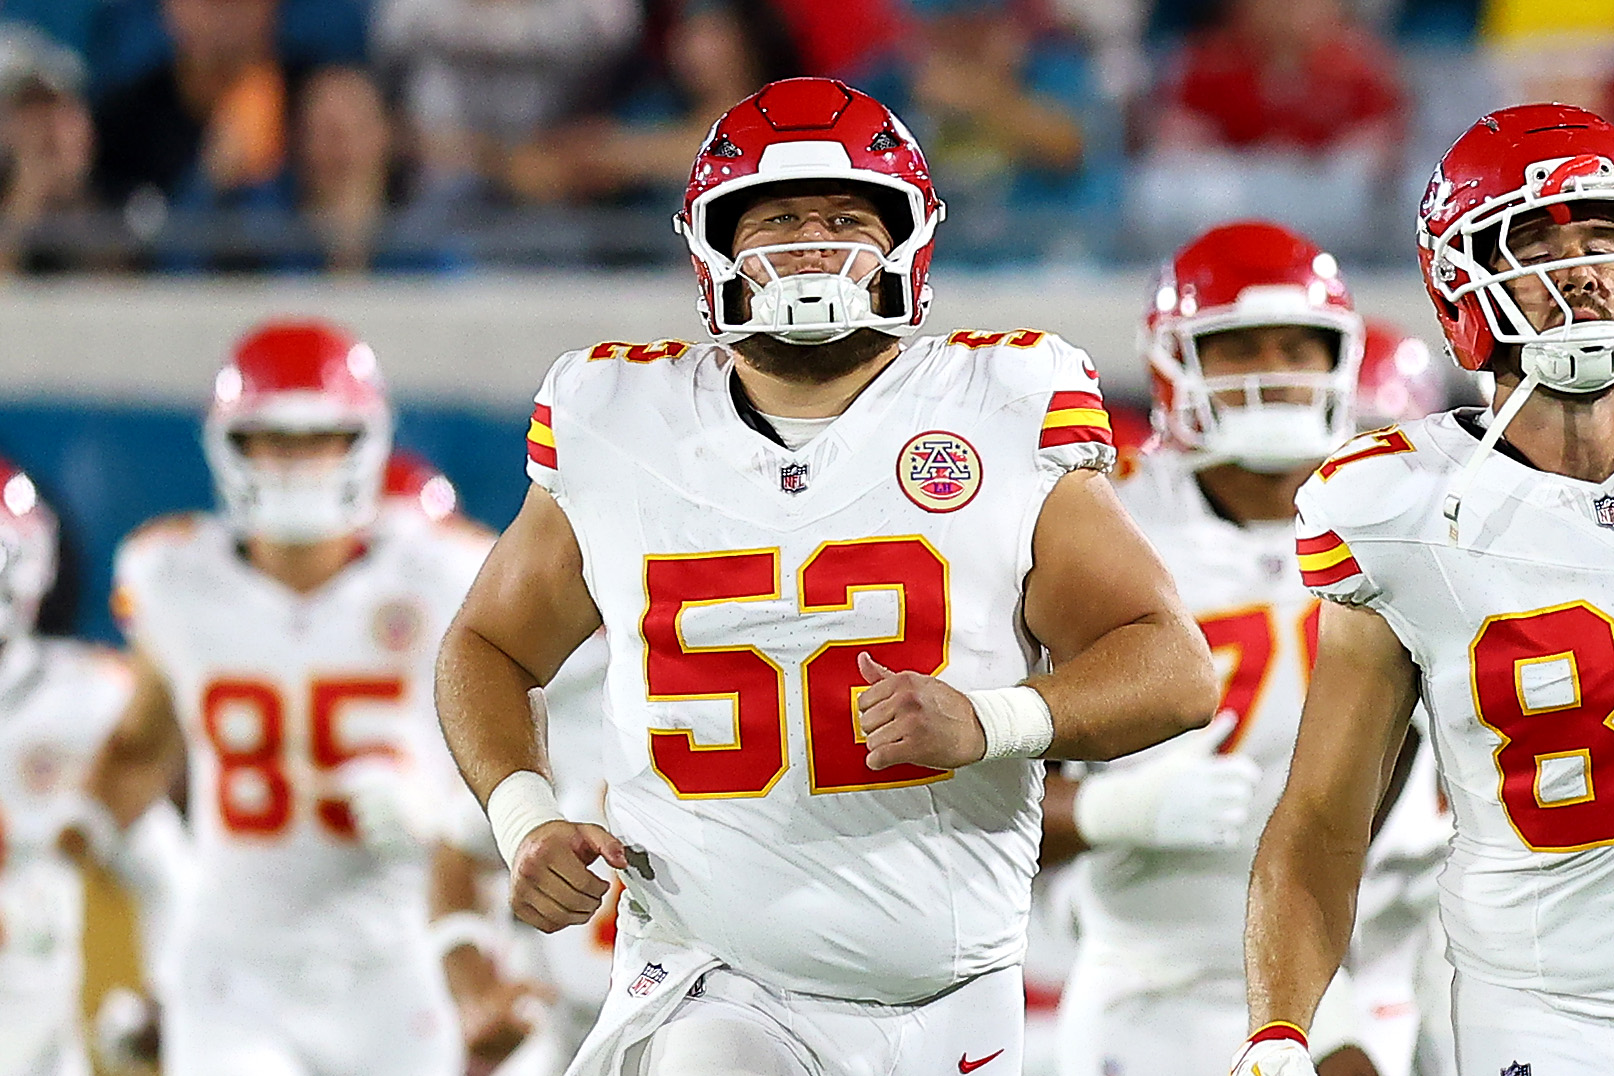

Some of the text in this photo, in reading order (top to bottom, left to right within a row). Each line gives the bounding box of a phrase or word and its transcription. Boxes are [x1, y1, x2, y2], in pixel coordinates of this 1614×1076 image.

[1314, 424, 1417, 484] 7
[640, 534, 955, 800] 52
[202, 676, 409, 840] 85
